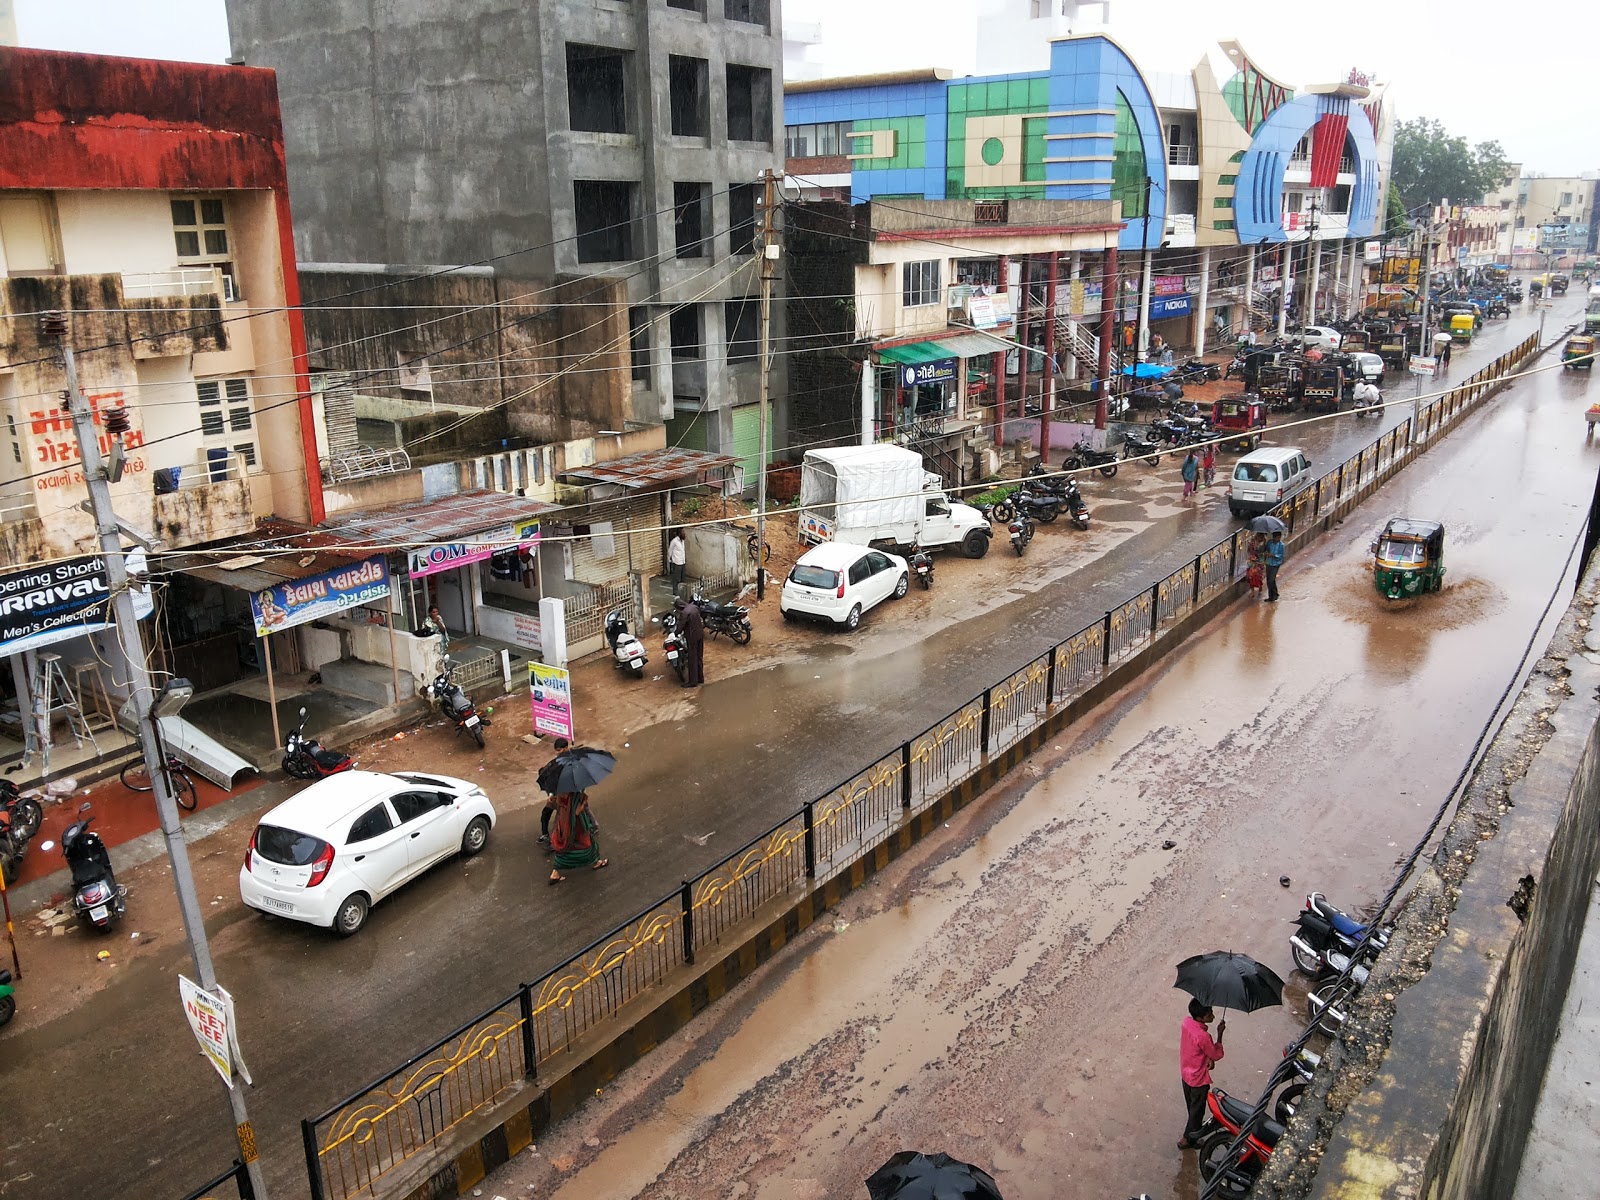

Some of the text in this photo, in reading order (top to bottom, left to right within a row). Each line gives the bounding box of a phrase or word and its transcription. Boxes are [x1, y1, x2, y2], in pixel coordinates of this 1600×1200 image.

[1164, 300, 1188, 311] NOKIA
[430, 543, 468, 564] OM
[0, 573, 51, 594] pening
[0, 577, 109, 616] RRIVAL
[70, 599, 88, 608] about
[3, 607, 100, 639] Men's Collection
[187, 1001, 225, 1034] NEET
[198, 1021, 224, 1045] JEE
